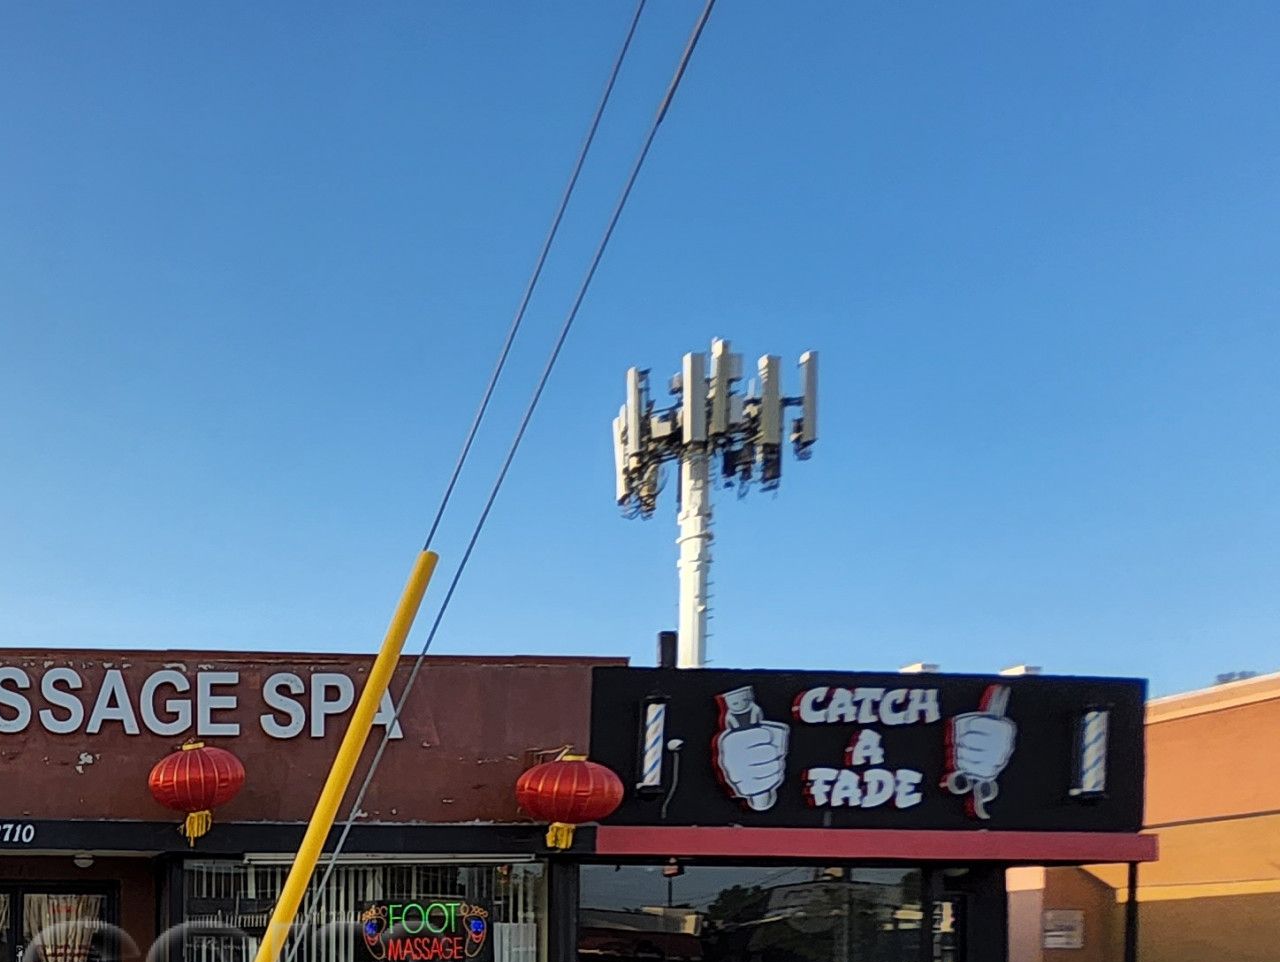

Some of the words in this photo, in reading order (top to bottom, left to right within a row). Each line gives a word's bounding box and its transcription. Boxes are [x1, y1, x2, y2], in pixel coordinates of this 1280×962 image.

[796, 686, 941, 726] CATCH
[849, 728, 885, 766] A
[804, 767, 924, 809] FADE
[388, 902, 461, 934] FOOT
[387, 936, 464, 961] MASSAGE
